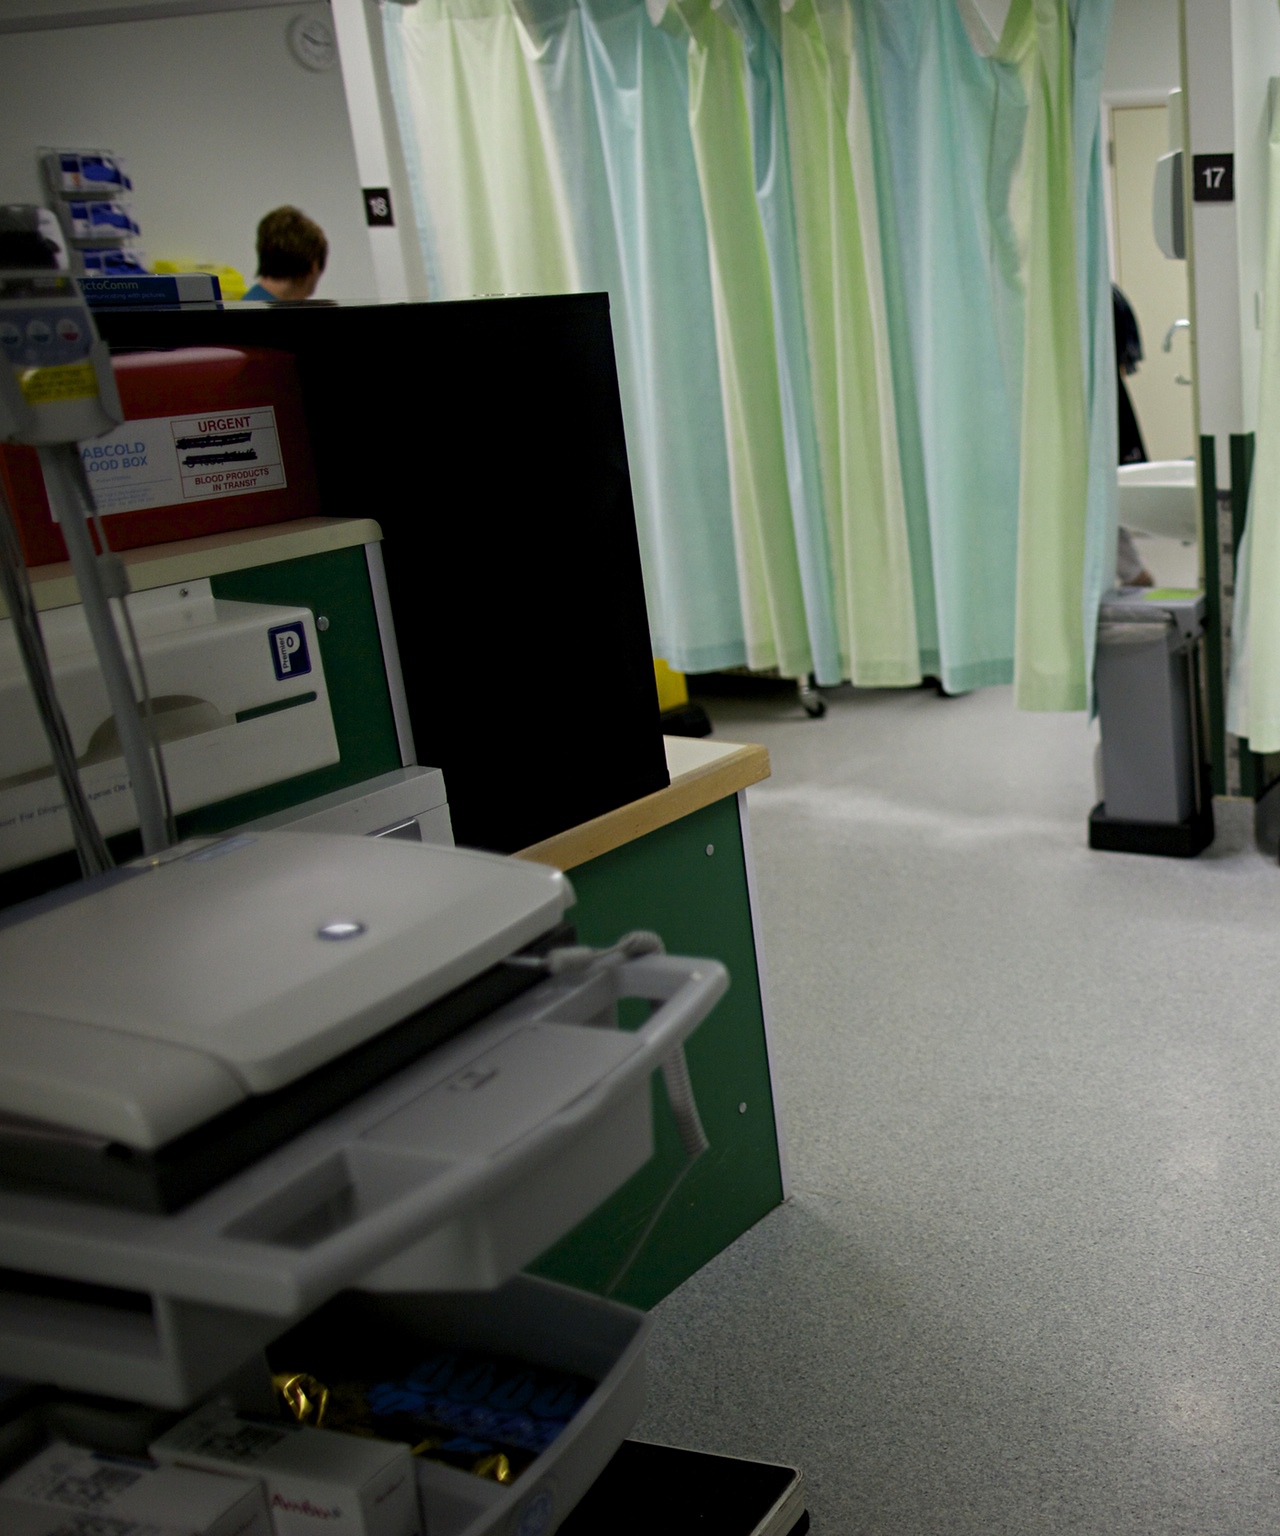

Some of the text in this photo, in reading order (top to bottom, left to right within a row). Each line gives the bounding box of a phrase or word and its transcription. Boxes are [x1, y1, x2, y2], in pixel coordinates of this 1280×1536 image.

[1202, 166, 1226, 189] 17
[368, 196, 389, 217] 18
[198, 416, 250, 433] URGENT
[81, 442, 146, 460] ABCOLD
[85, 455, 148, 473] OOD BOX
[195, 467, 269, 486] BLOOD PRODUCTS
[212, 478, 257, 492] IN TRANSIT
[278, 637, 289, 669] Premier
